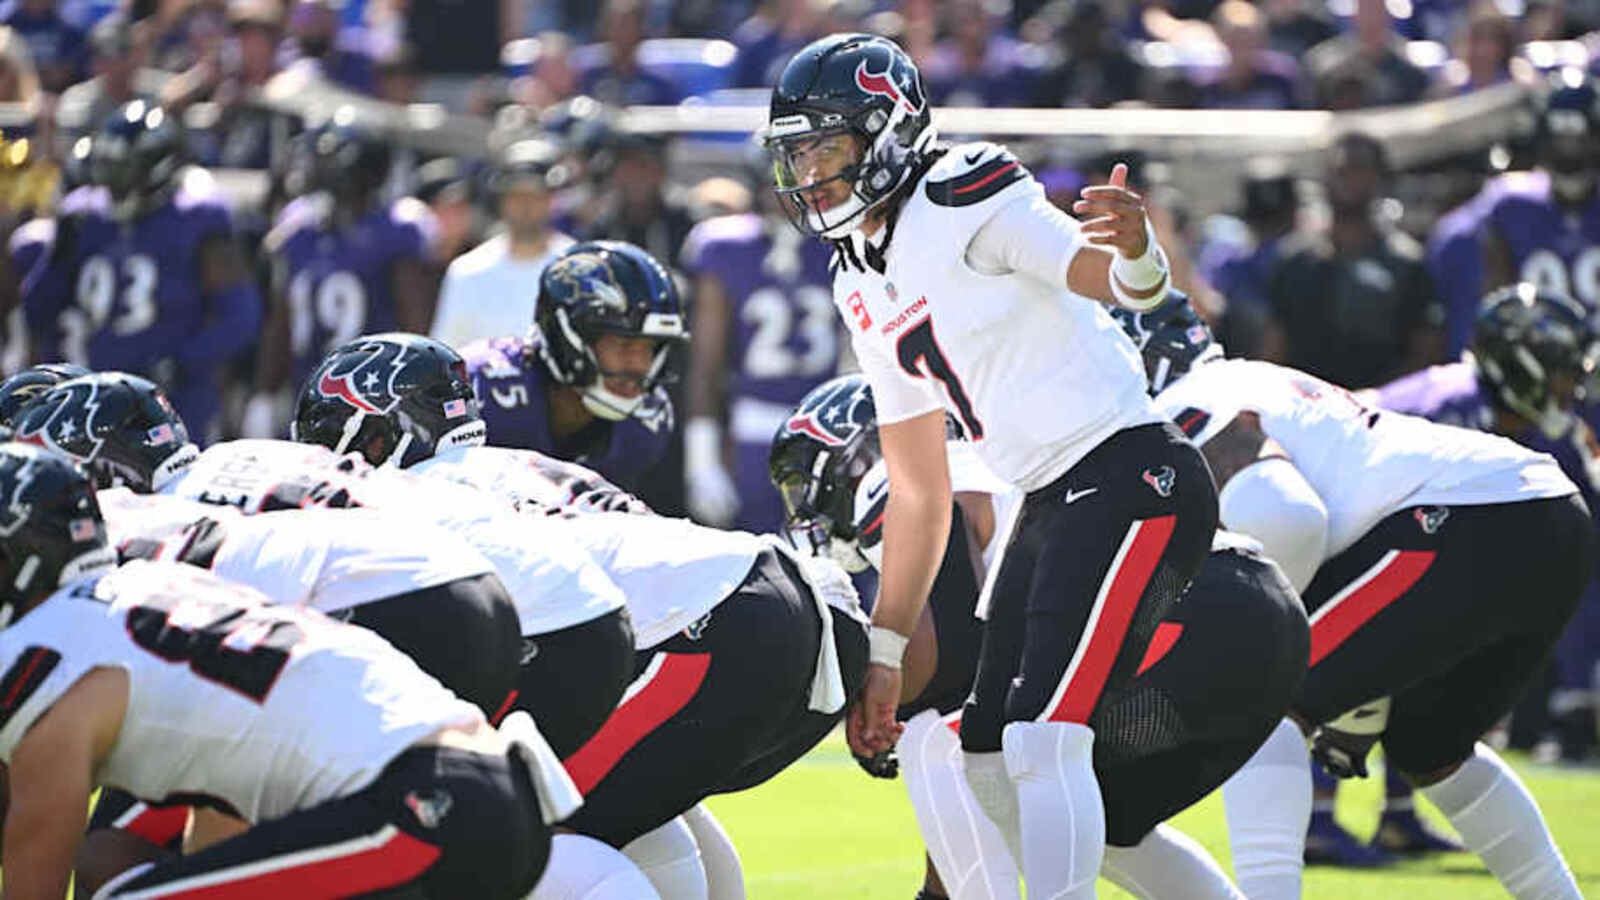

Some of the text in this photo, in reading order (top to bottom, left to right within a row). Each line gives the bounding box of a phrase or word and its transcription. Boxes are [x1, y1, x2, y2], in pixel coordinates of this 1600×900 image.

[742, 285, 835, 378] 23
[881, 295, 928, 335] HOUSTON
[896, 312, 983, 442] 7
